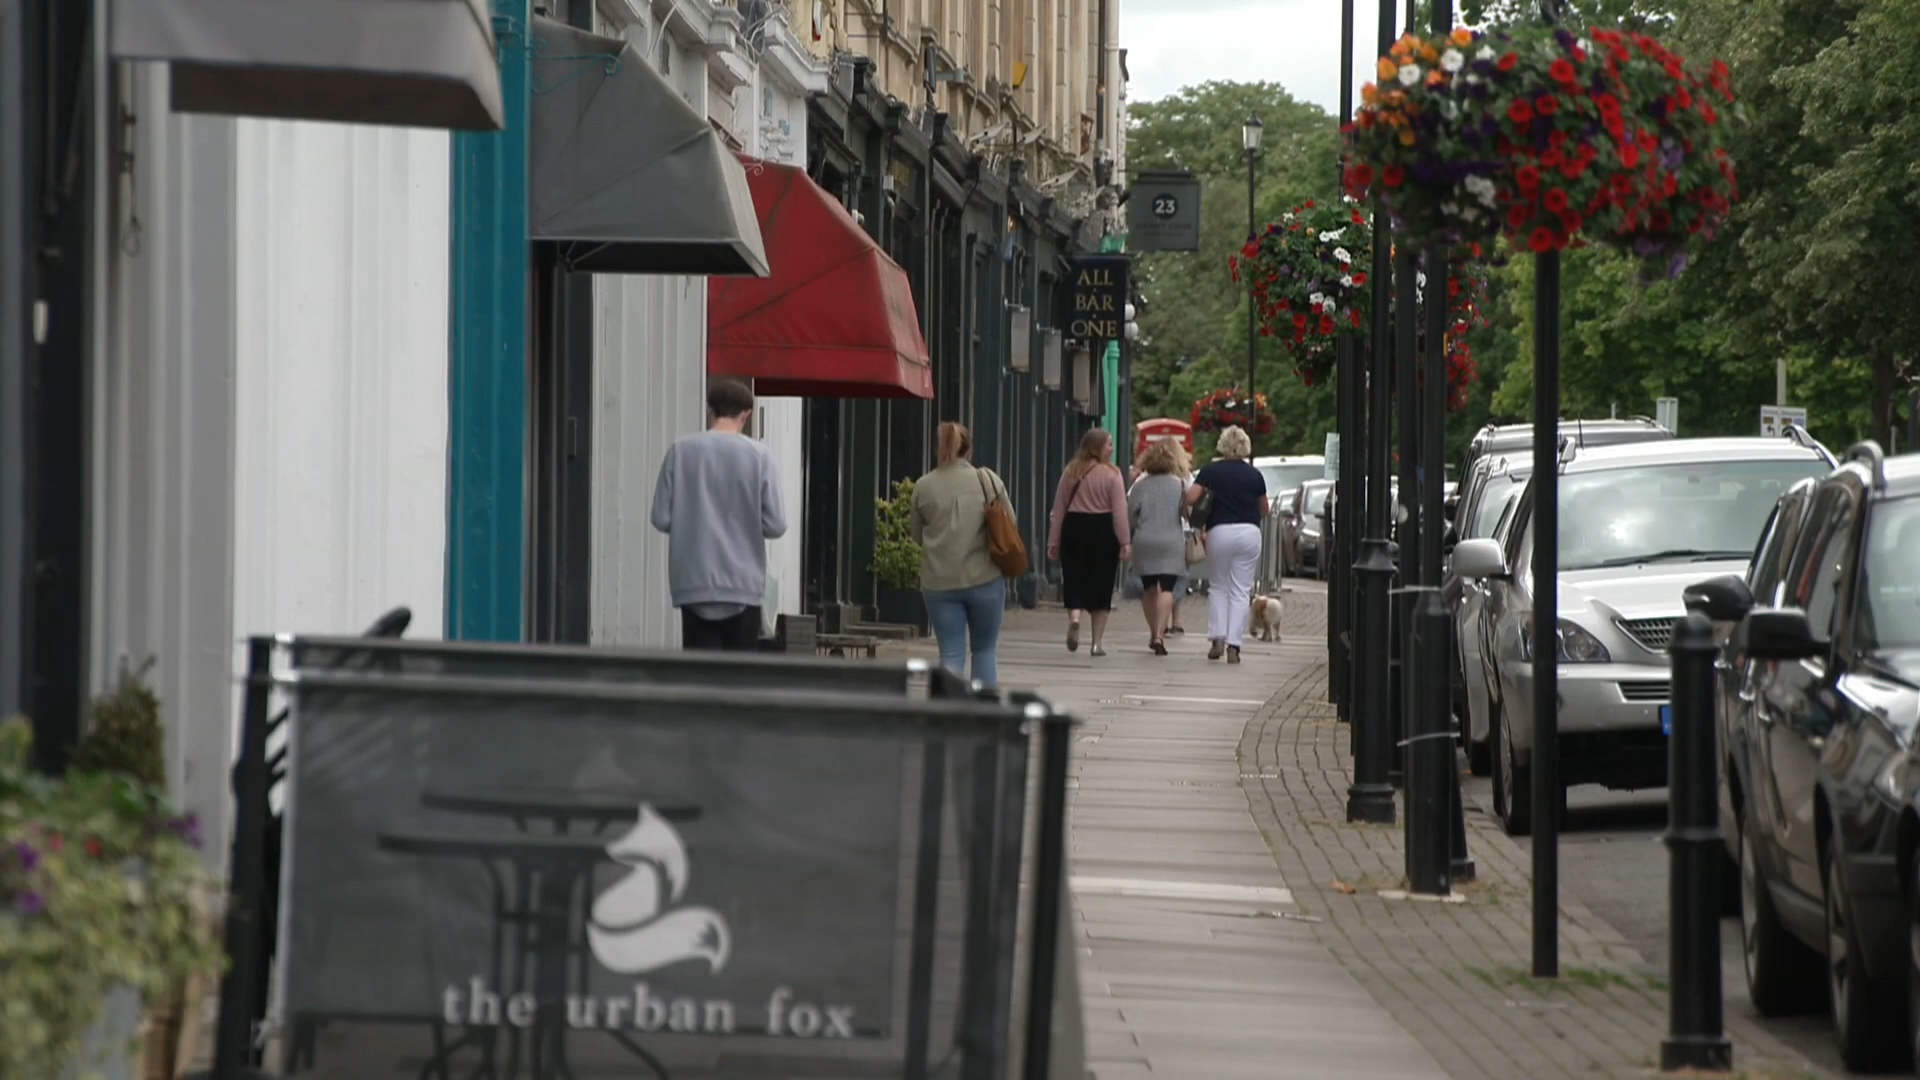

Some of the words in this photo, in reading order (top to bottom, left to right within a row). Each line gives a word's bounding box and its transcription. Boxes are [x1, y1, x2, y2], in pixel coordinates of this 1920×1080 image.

[1155, 200, 1175, 214] 23
[1078, 270, 1113, 286] ALL
[1076, 294, 1114, 312] BAR
[1071, 320, 1117, 336] ONE
[442, 976, 537, 1026] the
[566, 983, 735, 1034] urban
[766, 986, 855, 1039] fox
